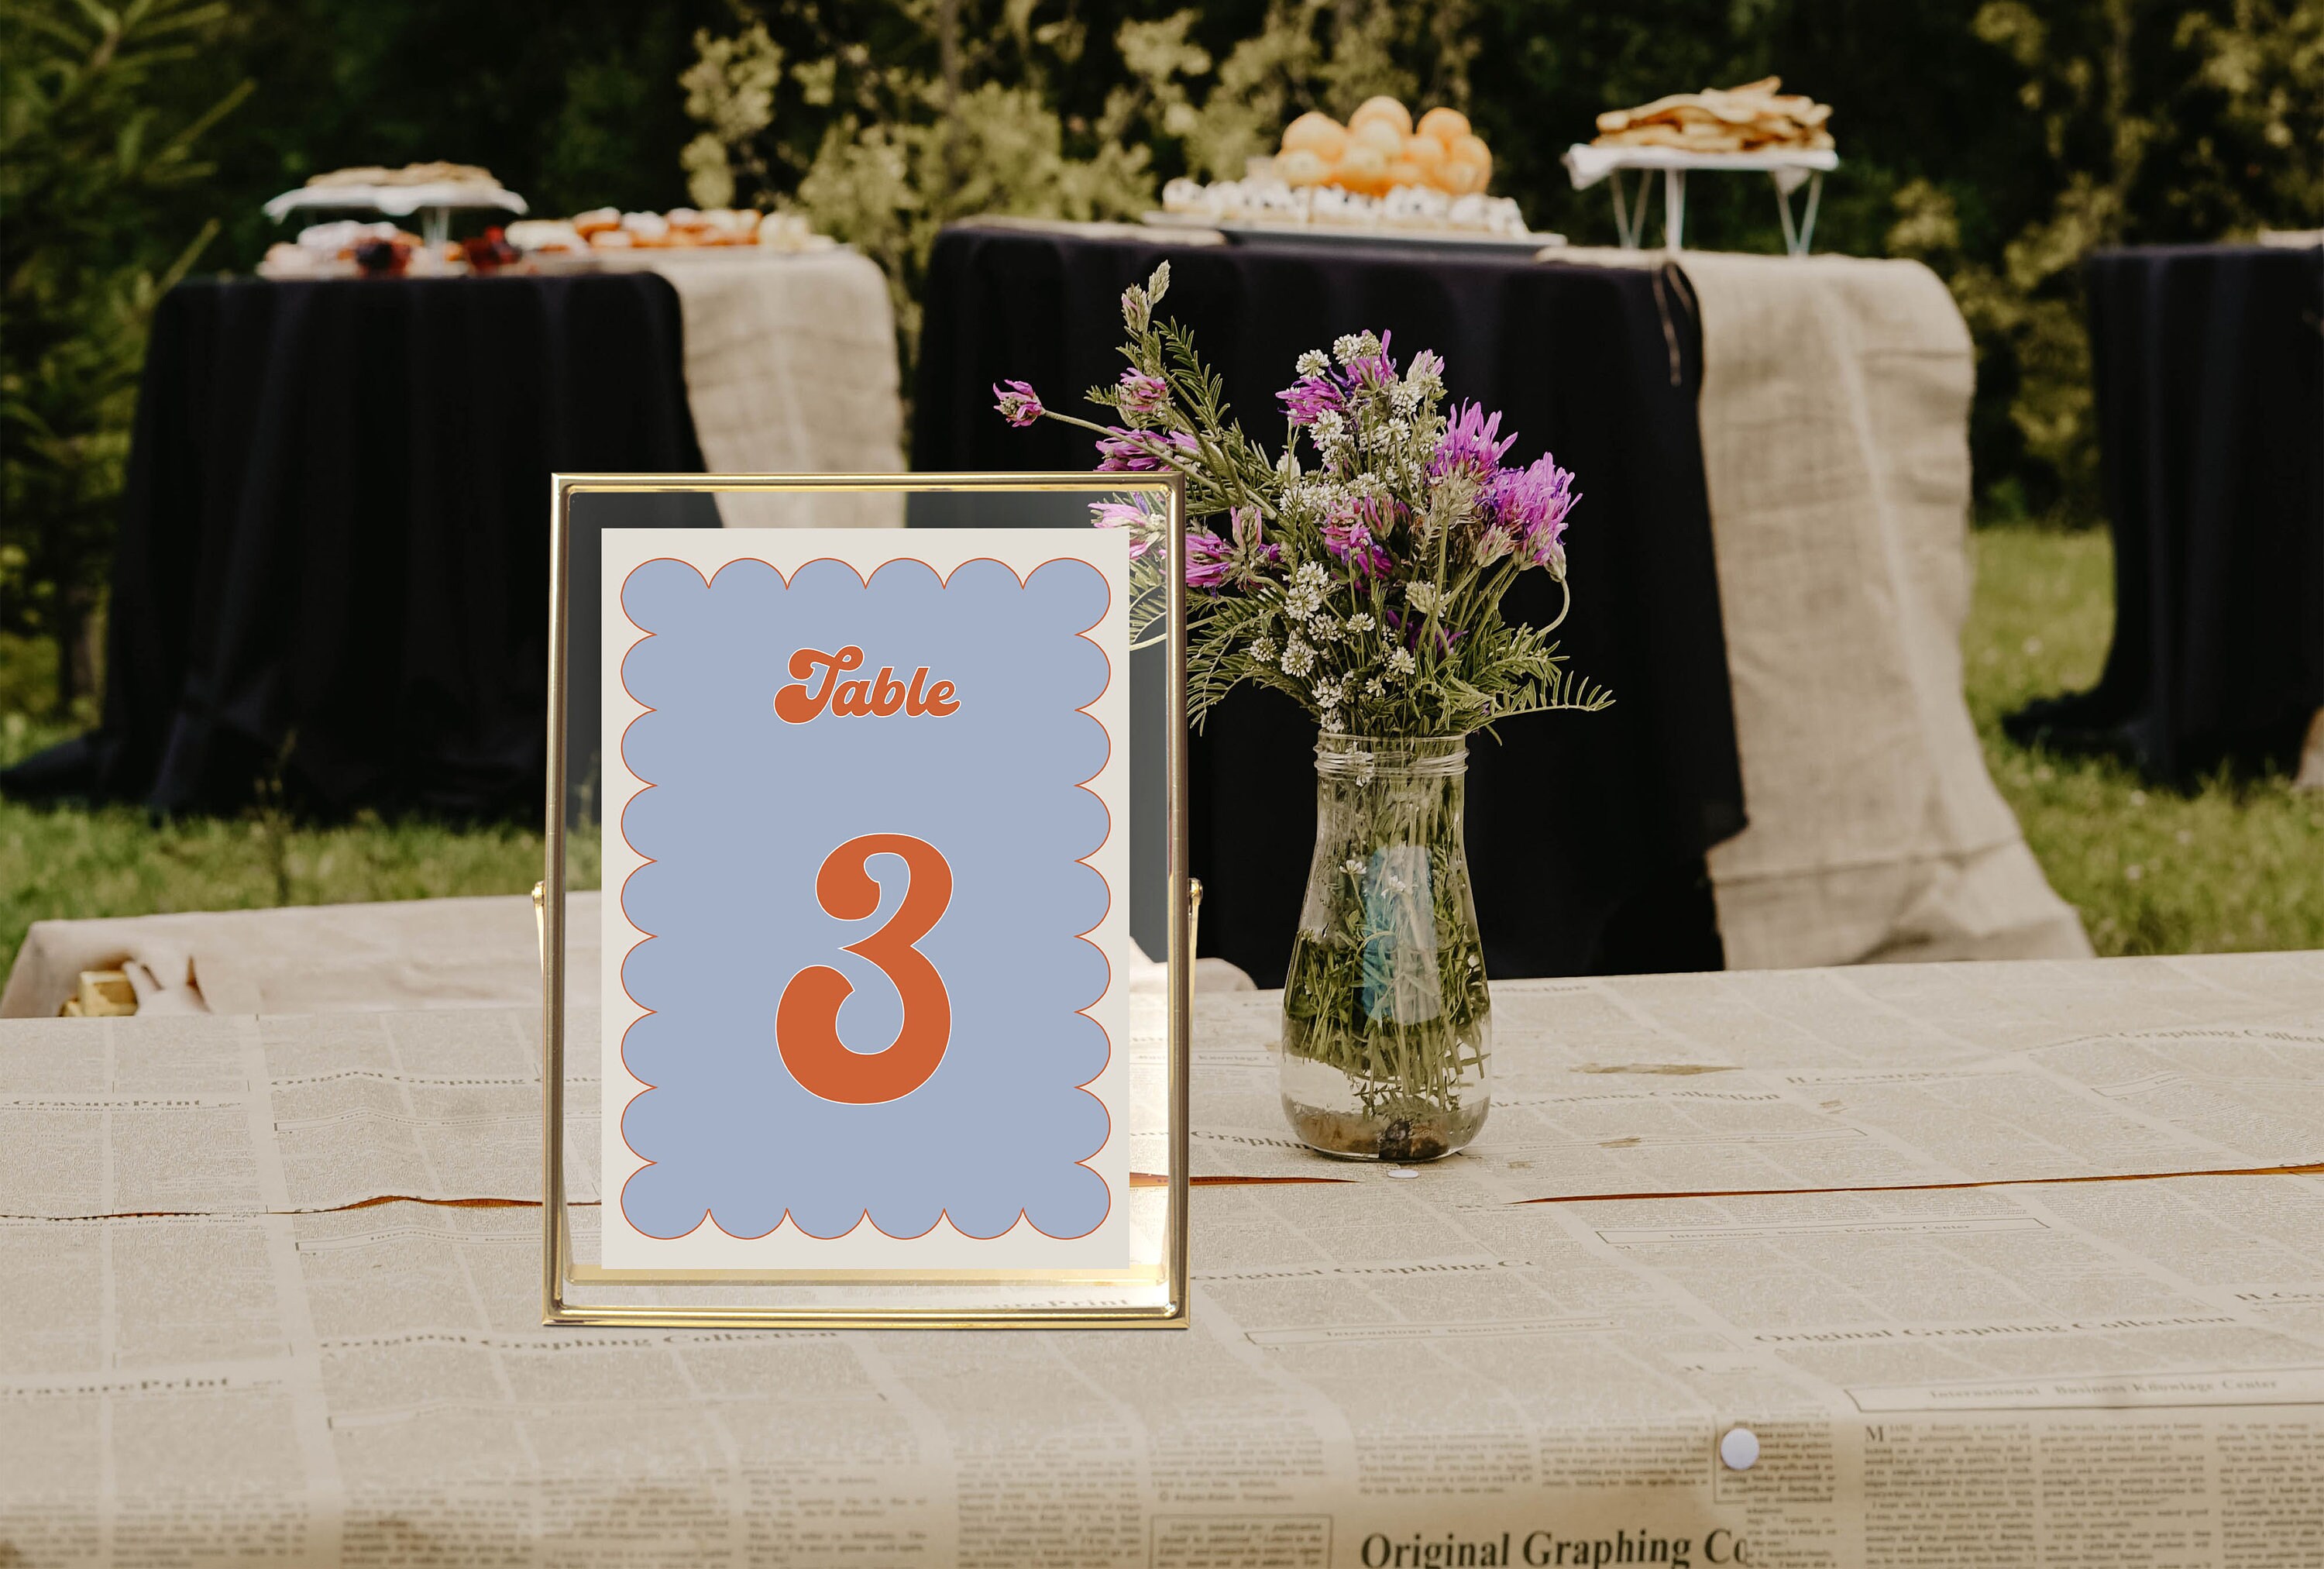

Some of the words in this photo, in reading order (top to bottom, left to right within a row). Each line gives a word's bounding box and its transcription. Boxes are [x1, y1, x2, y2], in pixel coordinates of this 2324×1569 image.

[774, 645, 961, 724] Table
[775, 833, 954, 1105] 3
[1361, 1532, 1510, 1569] Original
[1523, 1529, 1692, 1569] Graphing
